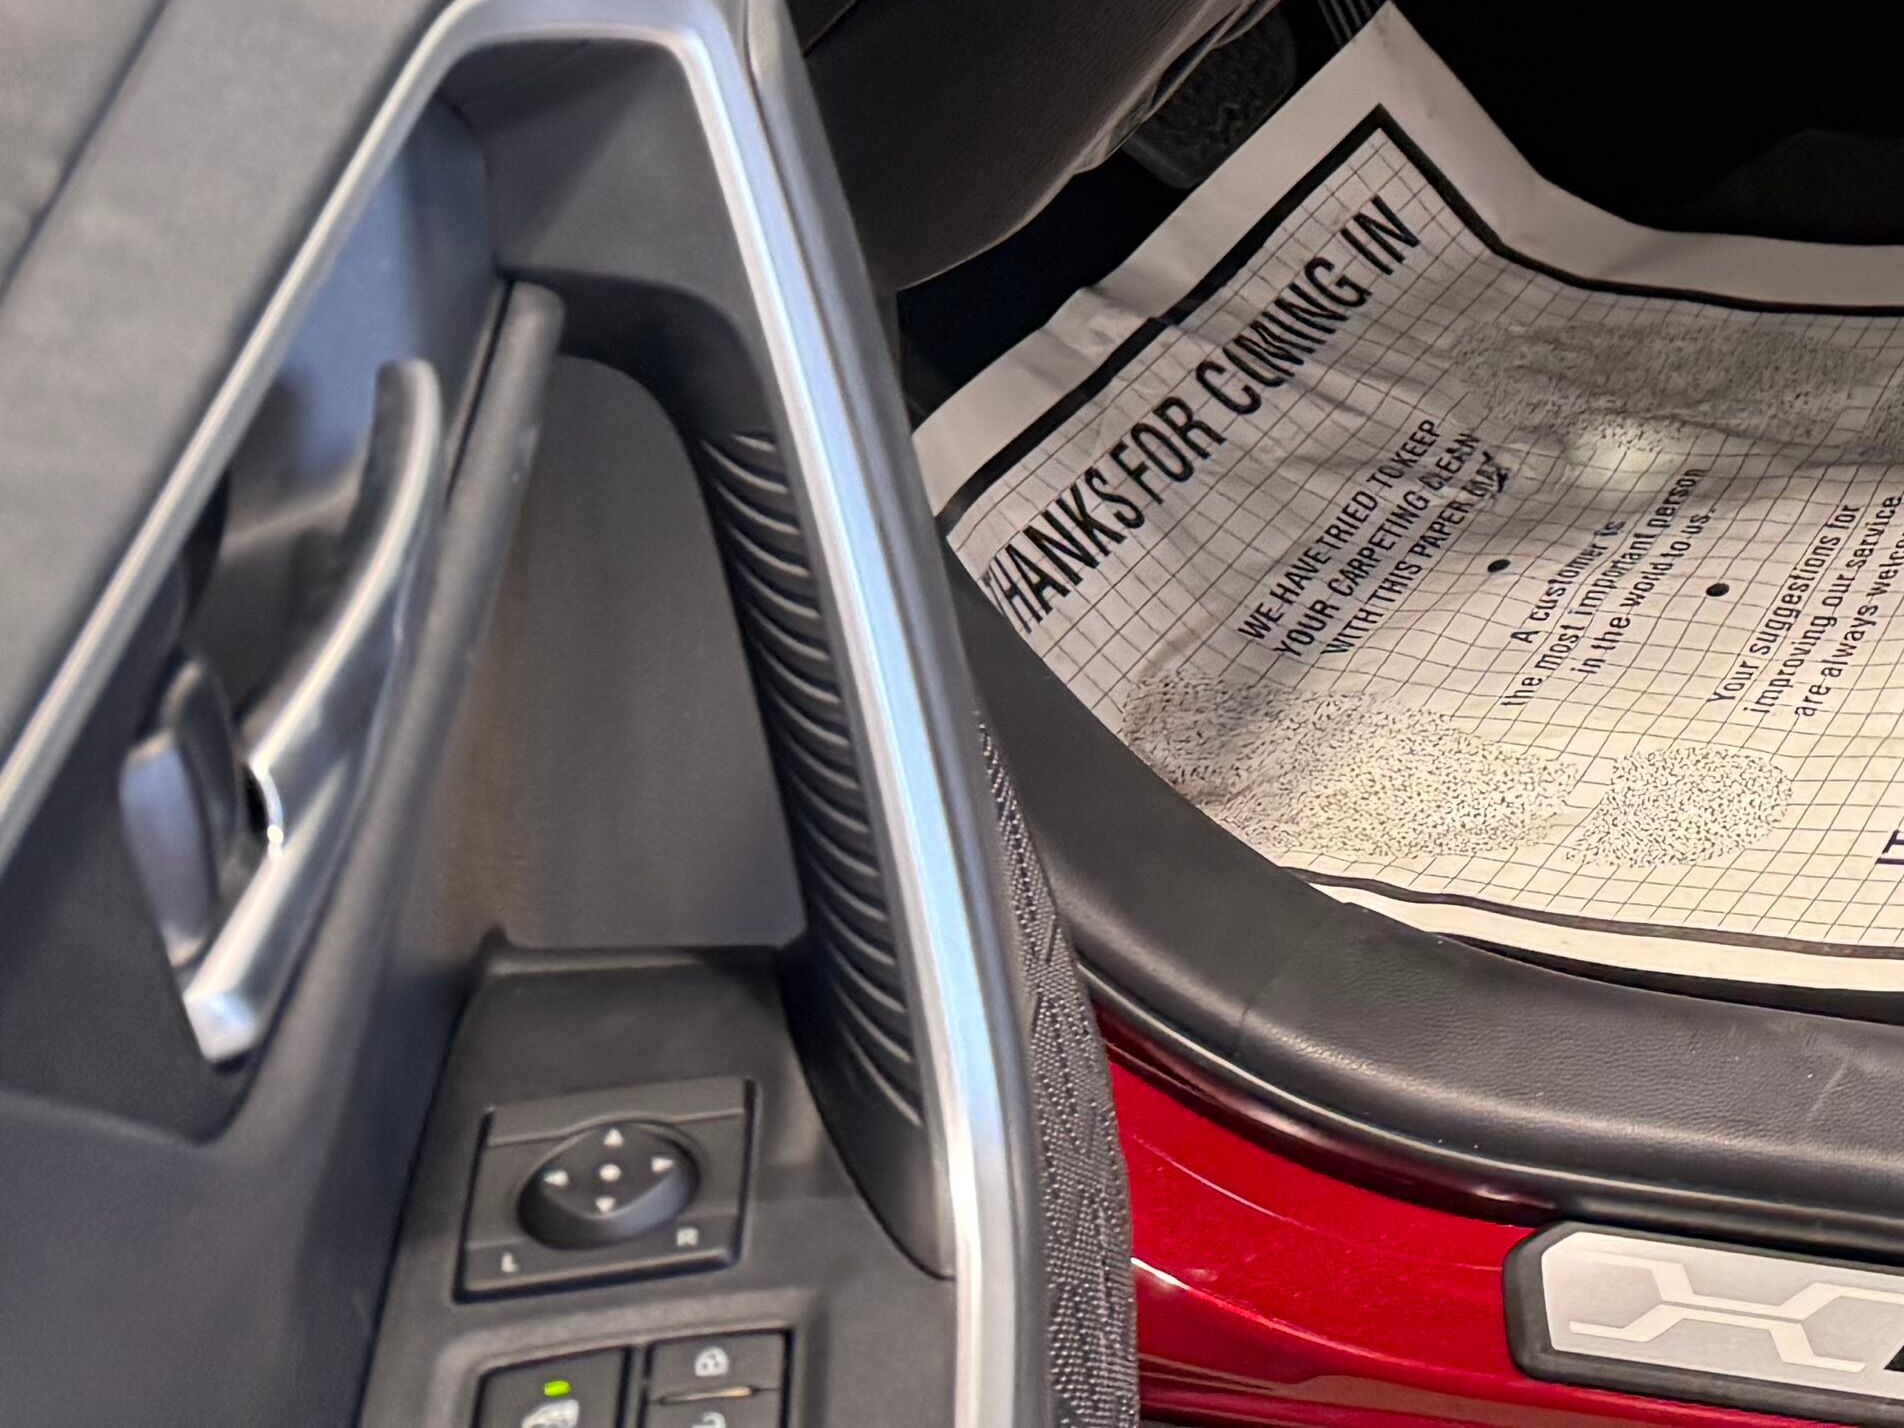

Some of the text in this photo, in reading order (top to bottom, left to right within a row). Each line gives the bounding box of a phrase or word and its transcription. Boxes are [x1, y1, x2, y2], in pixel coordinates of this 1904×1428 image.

[1110, 396, 1226, 504] FOR
[1196, 257, 1371, 414] COMING
[1340, 196, 1420, 274] IN
[1238, 420, 1440, 640] WE HAVE TRIED TO KEEP
[1273, 600, 1340, 657] YOUR
[1328, 490, 1428, 596] CARPETING
[1320, 608, 1383, 656] WITH
[1372, 561, 1423, 604] THIS
[1409, 499, 1473, 558] PAPER
[1501, 468, 1709, 707] the most important person
[1511, 519, 1627, 643] A customer is
[1571, 657, 1606, 675] in
[1591, 615, 1631, 651] the
[1619, 560, 1674, 608] world
[1660, 540, 1690, 559] to
[1706, 504, 1862, 705] Your suggestions for
[1744, 496, 1903, 714] improving our service
[1795, 684, 1832, 717] are
[1819, 604, 1879, 678] always
